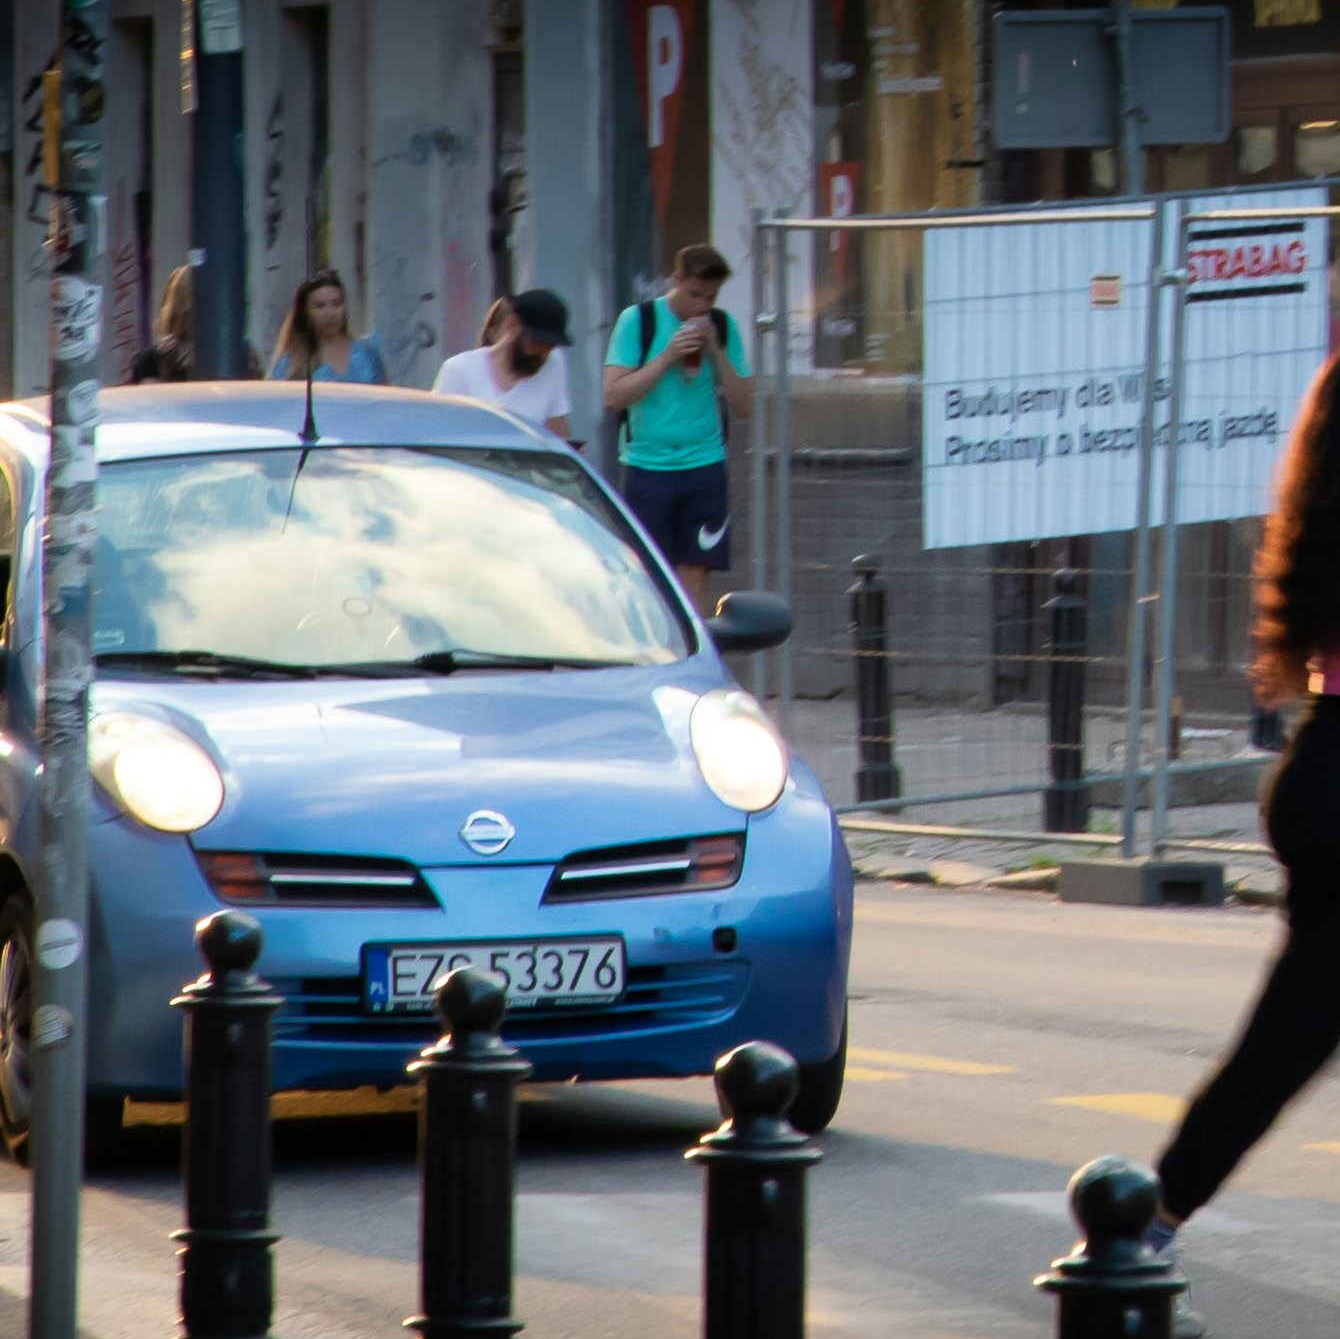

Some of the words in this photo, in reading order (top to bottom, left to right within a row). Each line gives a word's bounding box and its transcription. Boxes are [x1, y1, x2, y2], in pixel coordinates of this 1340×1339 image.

[647, 4, 684, 148] P
[946, 388, 1069, 423] Budujemy
[1075, 378, 1113, 409] dla
[490, 946, 617, 992] 53376
